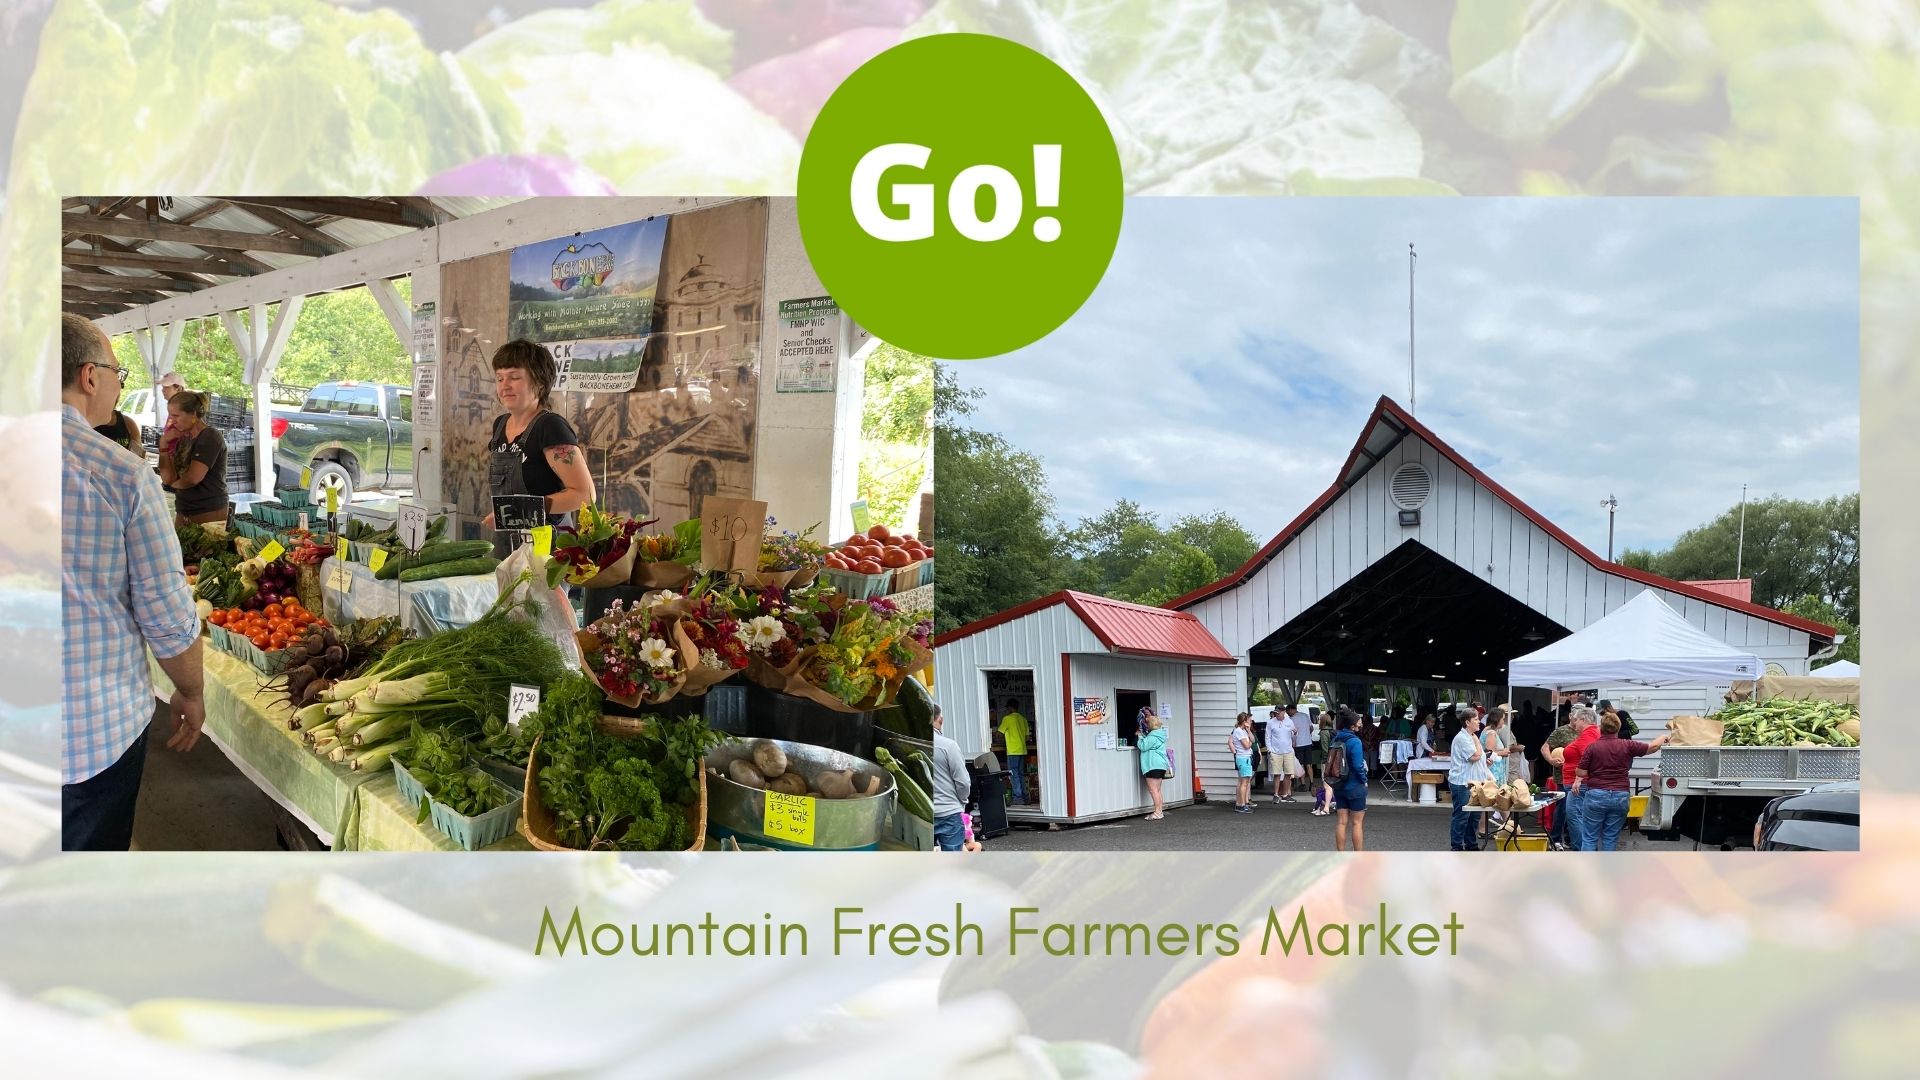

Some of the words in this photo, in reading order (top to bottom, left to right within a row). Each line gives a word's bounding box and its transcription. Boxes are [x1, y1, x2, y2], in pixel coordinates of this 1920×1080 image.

[783, 301, 810, 310] Farmers
[811, 298, 834, 307] Market
[517, 311, 541, 321] Working
[544, 310, 556, 318] with
[559, 306, 582, 316] Mother
[584, 303, 607, 313] Nature
[611, 300, 630, 310] Since
[780, 310, 807, 319] Nutrition
[808, 308, 837, 317] Program
[790, 319, 810, 328] FMNP
[811, 318, 825, 327] WIC
[800, 328, 813, 337] and
[783, 339, 804, 347] Senior
[805, 337, 831, 346] Checks
[780, 347, 814, 356] ACCEPTED
[815, 345, 834, 354] HERE
[570, 372, 601, 382] Sustainably
[603, 373, 620, 381] Grown
[709, 514, 748, 541] $10
[769, 791, 808, 806] GARLIC
[769, 803, 785, 814] $3
[788, 808, 809, 817] single
[768, 820, 783, 831] $5
[789, 823, 806, 836] box
